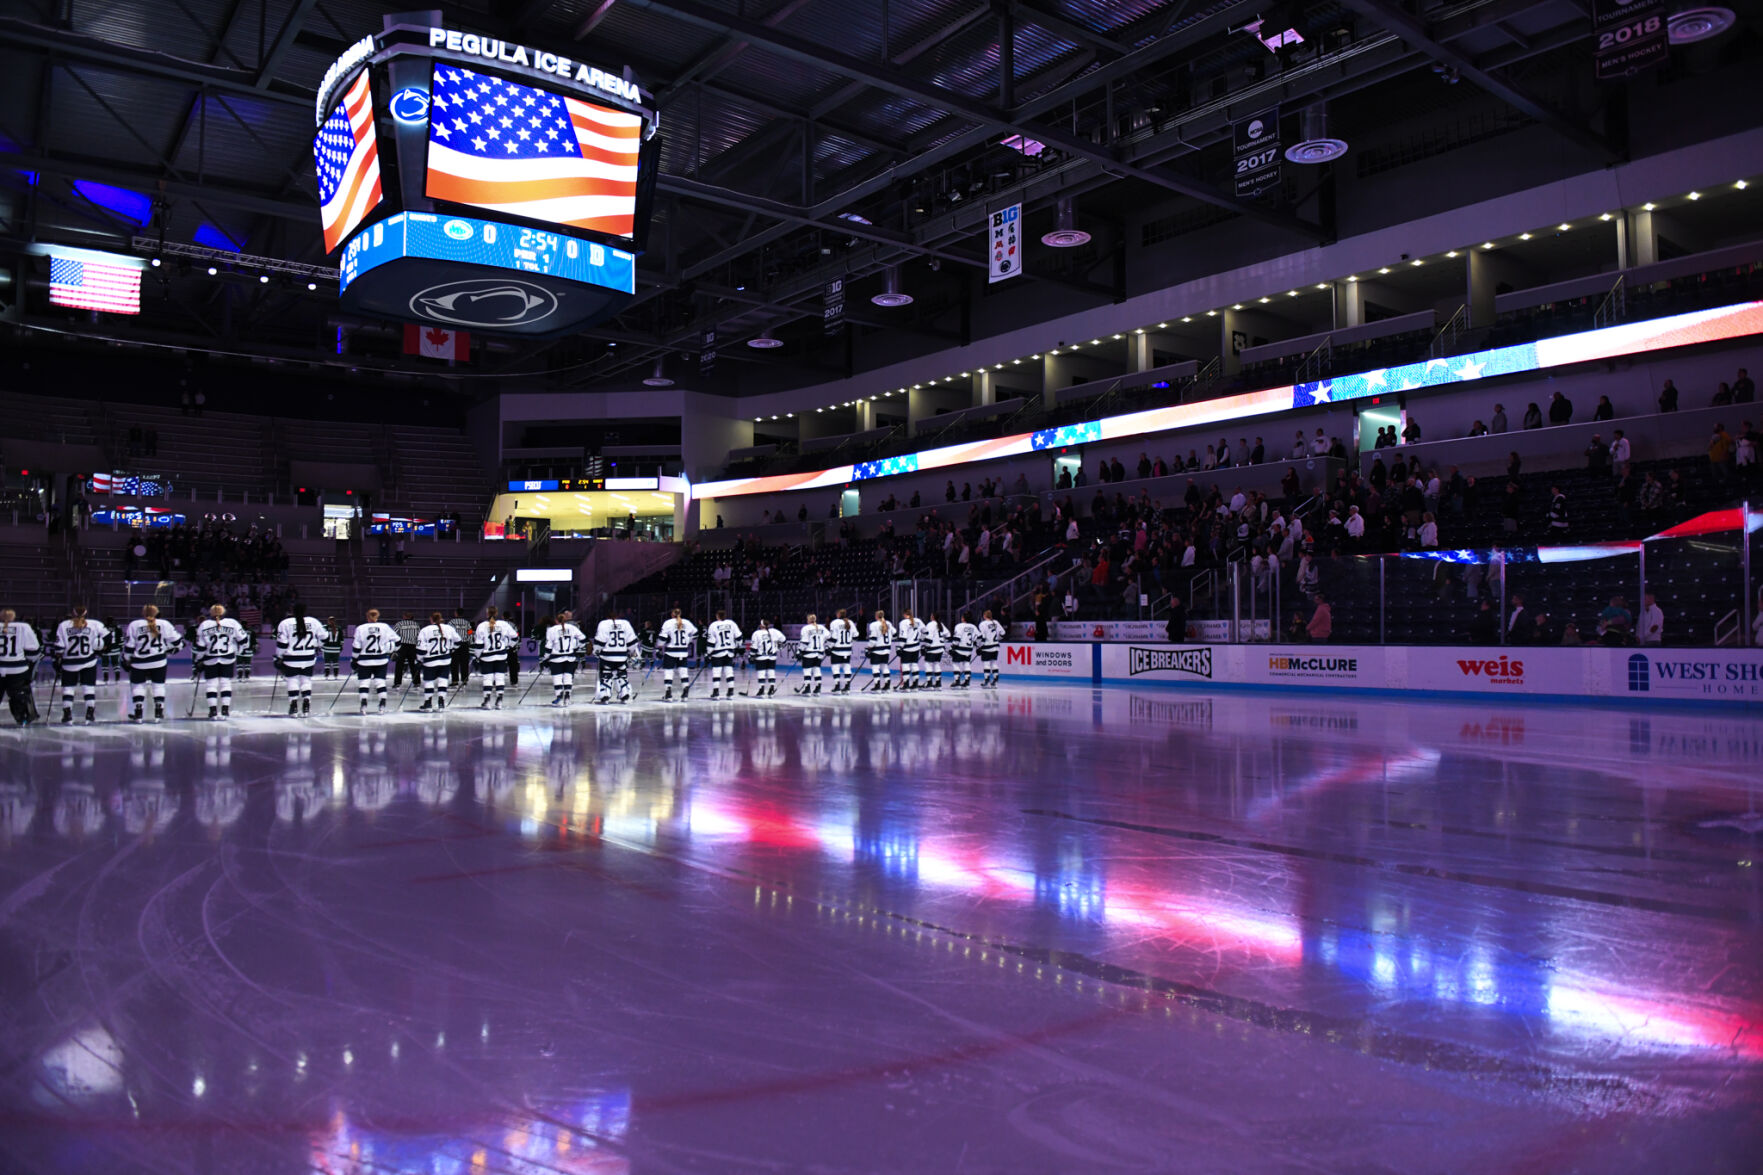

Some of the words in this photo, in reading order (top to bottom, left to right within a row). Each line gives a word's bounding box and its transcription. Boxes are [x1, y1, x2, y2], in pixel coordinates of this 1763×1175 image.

[1599, 16, 1661, 50] 2018
[1627, 41, 1662, 60] HOCKEY
[429, 27, 528, 66] PEGULA
[534, 49, 571, 78] ICE
[575, 63, 642, 105] ARENA
[1236, 133, 1275, 152] TOURNAMENT
[1236, 148, 1276, 173] 2017
[1255, 170, 1277, 182] HOCKEY
[484, 224, 496, 244] 0
[520, 229, 557, 251] 2:54
[567, 240, 577, 258] 0
[825, 303, 843, 319] 2017
[67, 635, 90, 657] 26
[138, 633, 162, 655] 24
[209, 633, 229, 654] 23
[292, 630, 315, 651] 22
[366, 634, 382, 654] 21
[428, 637, 447, 656] 20
[488, 632, 502, 651] 18
[558, 635, 571, 653] 17
[608, 630, 625, 648] 35
[719, 630, 731, 647] 15
[812, 635, 821, 650] 11
[840, 630, 851, 645] 10
[965, 632, 973, 646] 3
[761, 639, 773, 656] 12
[1007, 645, 1032, 665] MI
[1035, 651, 1072, 659] WINDOWS
[1130, 648, 1150, 674] ICE
[1150, 650, 1210, 675] BREAKERS
[1456, 655, 1523, 676] weis
[1655, 662, 1721, 680] WEST
